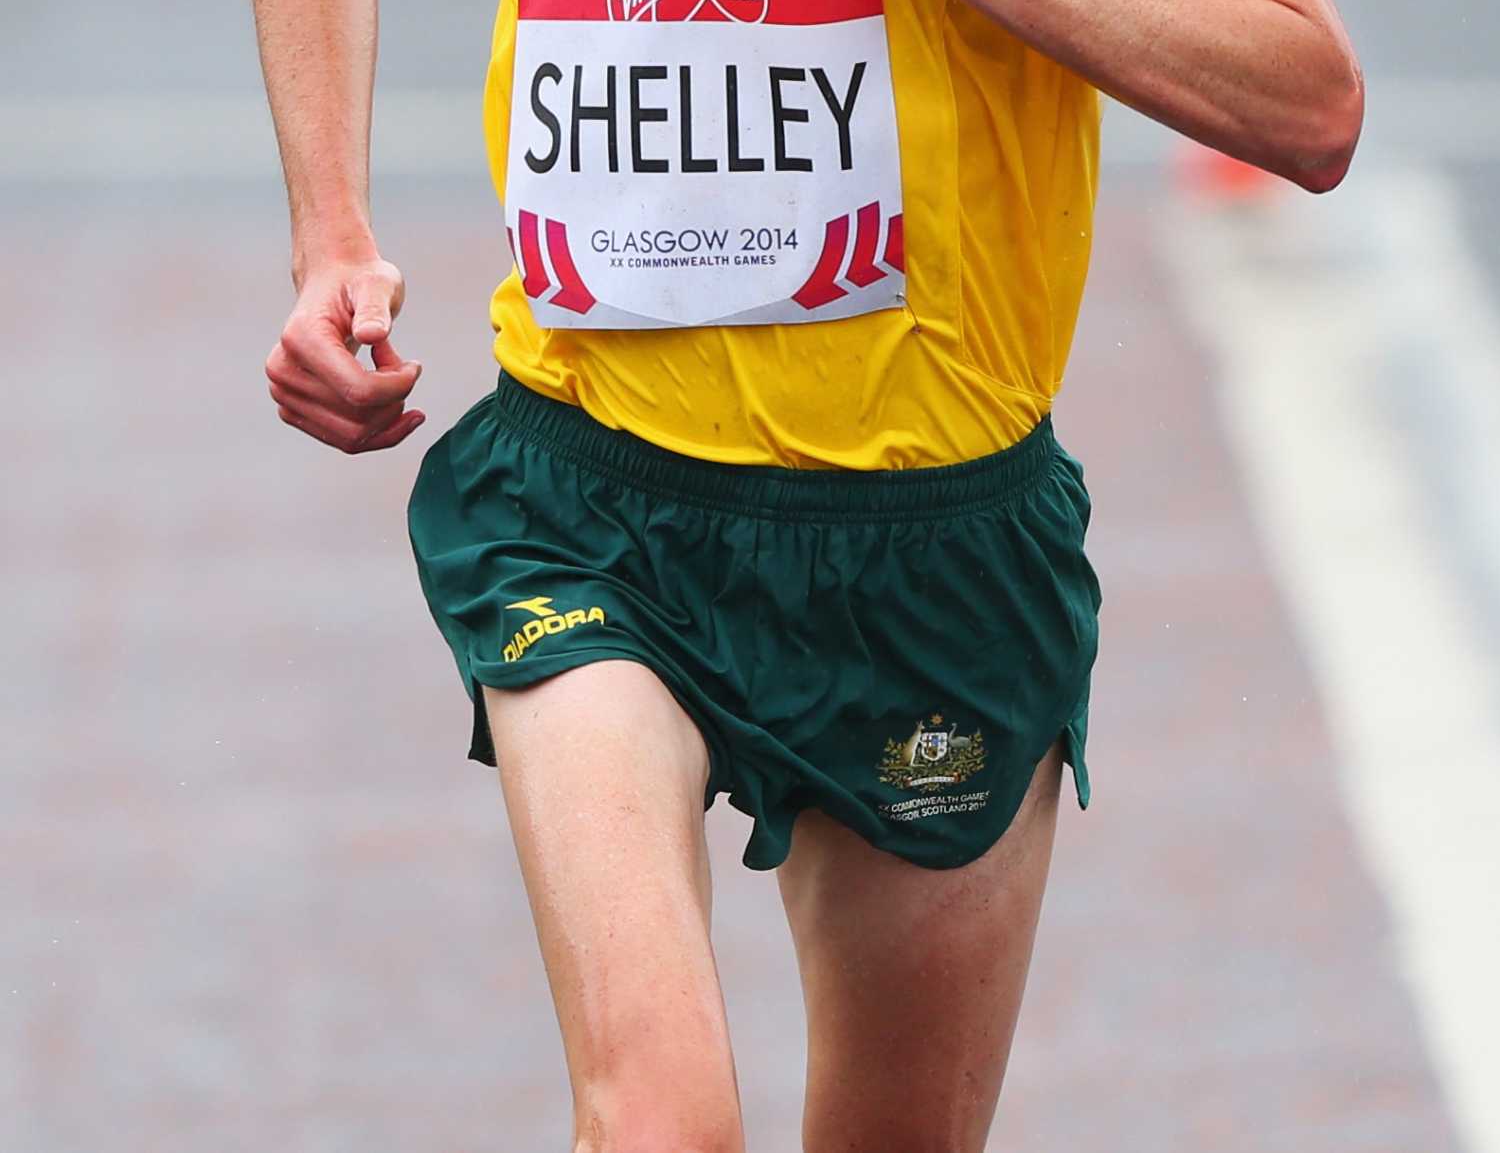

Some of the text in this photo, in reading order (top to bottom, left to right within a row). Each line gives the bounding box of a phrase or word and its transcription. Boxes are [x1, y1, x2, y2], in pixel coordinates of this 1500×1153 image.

[523, 61, 868, 175] SHELLEY
[591, 228, 799, 254] GLASGOW 2014
[609, 254, 777, 268] XX COMMONWEALTH GAMES
[503, 606, 606, 663] DIADORA
[921, 803, 967, 818] SCOTLAND
